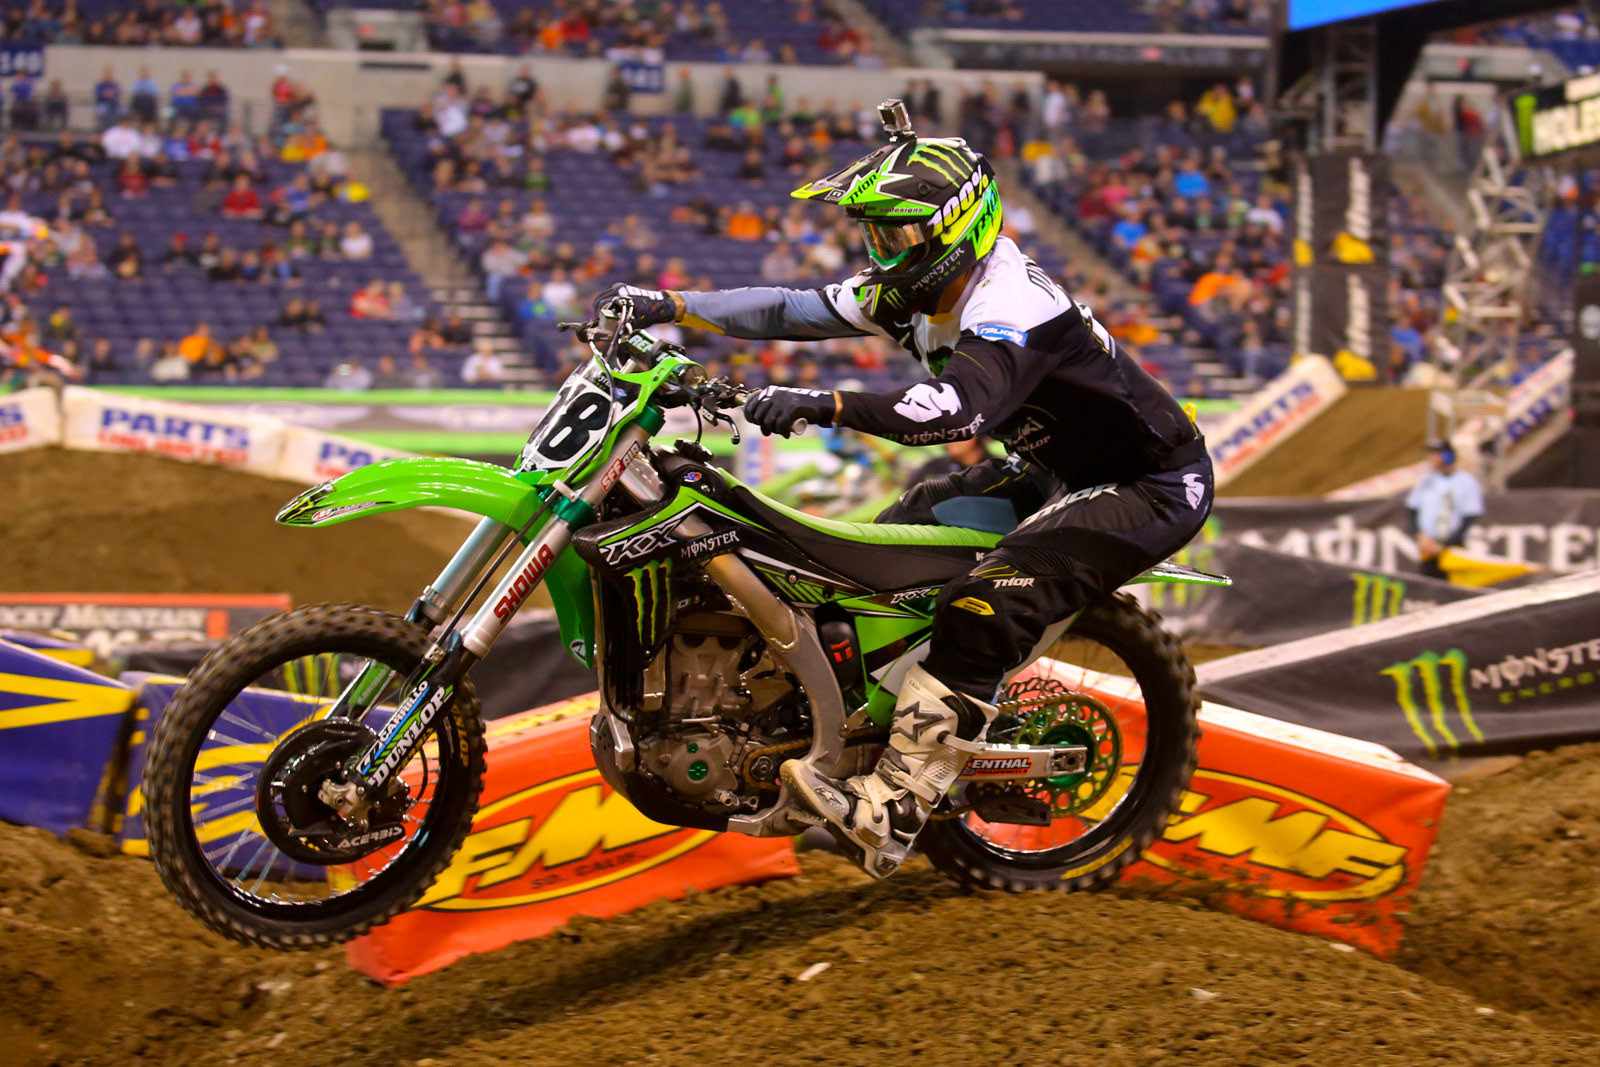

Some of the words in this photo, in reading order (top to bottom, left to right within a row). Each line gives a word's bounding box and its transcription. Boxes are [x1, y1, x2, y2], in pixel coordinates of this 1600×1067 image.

[849, 172, 878, 204] THOR
[926, 164, 989, 238] 100%
[911, 247, 965, 291] MONSTER
[902, 412, 985, 445] MONSTER
[680, 530, 740, 559] MONSTER
[493, 543, 555, 624] SHOWA
[993, 576, 1036, 590] THOR
[1470, 638, 1600, 690] MONSTE
[379, 680, 429, 742] CARRILLO
[368, 686, 446, 788] DUNLOP
[971, 758, 1031, 769] ENTHAL
[337, 826, 403, 849] ACERBIS
